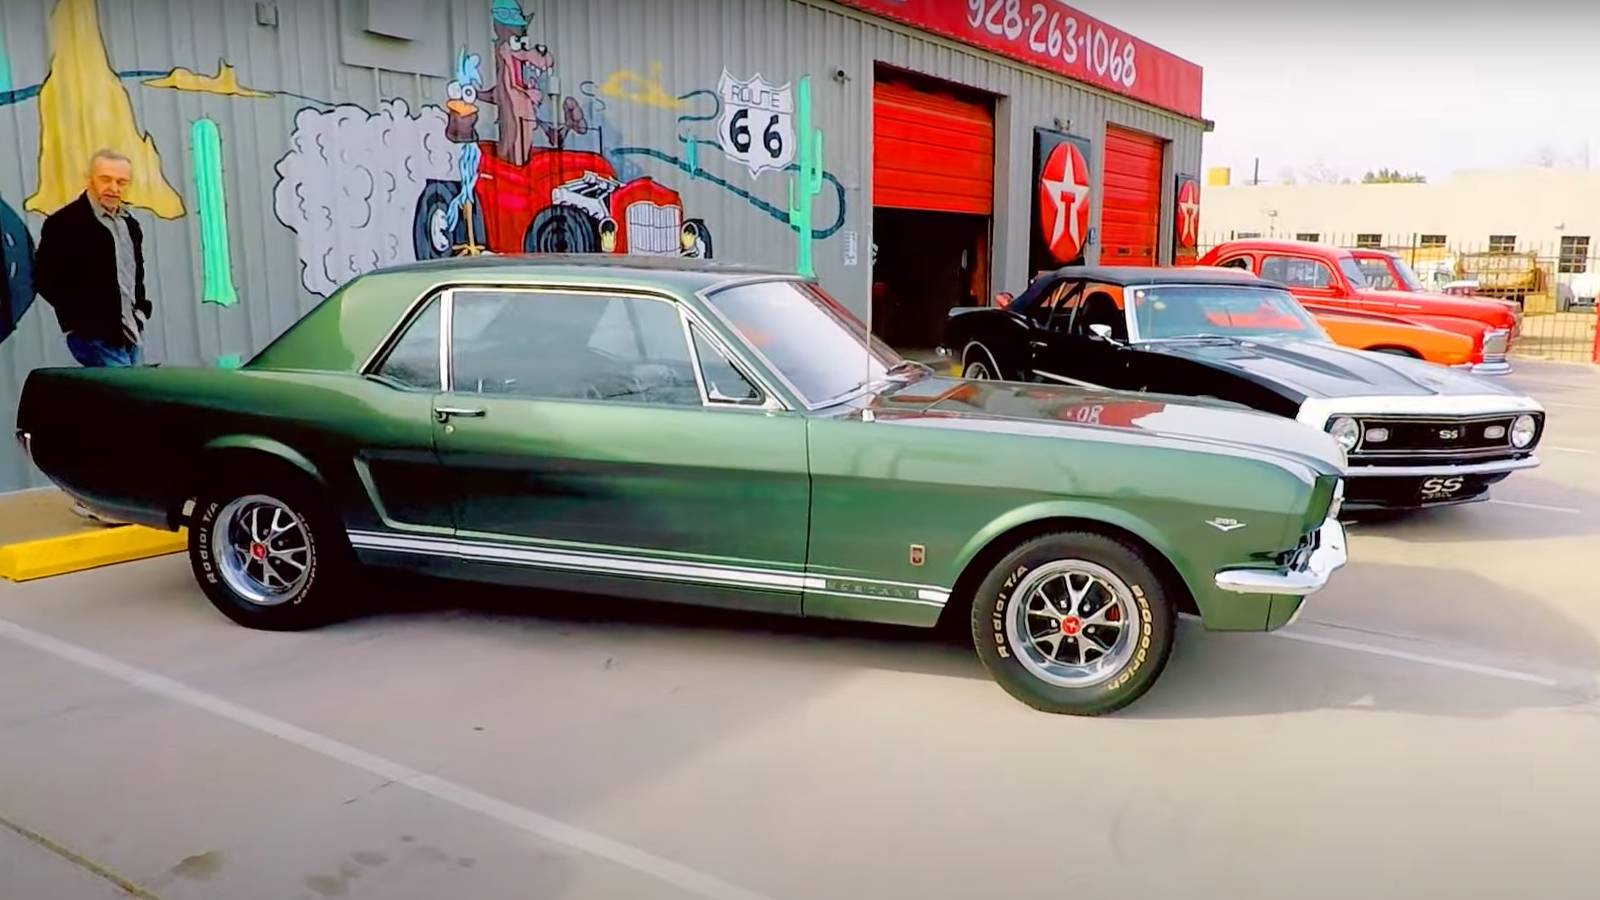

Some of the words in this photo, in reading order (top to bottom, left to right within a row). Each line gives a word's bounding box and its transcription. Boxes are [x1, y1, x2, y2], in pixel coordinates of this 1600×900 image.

[731, 85, 780, 108] ROUTE
[1440, 430, 1458, 439] SS
[1421, 477, 1464, 494] SS
[991, 593, 1011, 659] Radial
[1004, 565, 1028, 590] T/A
